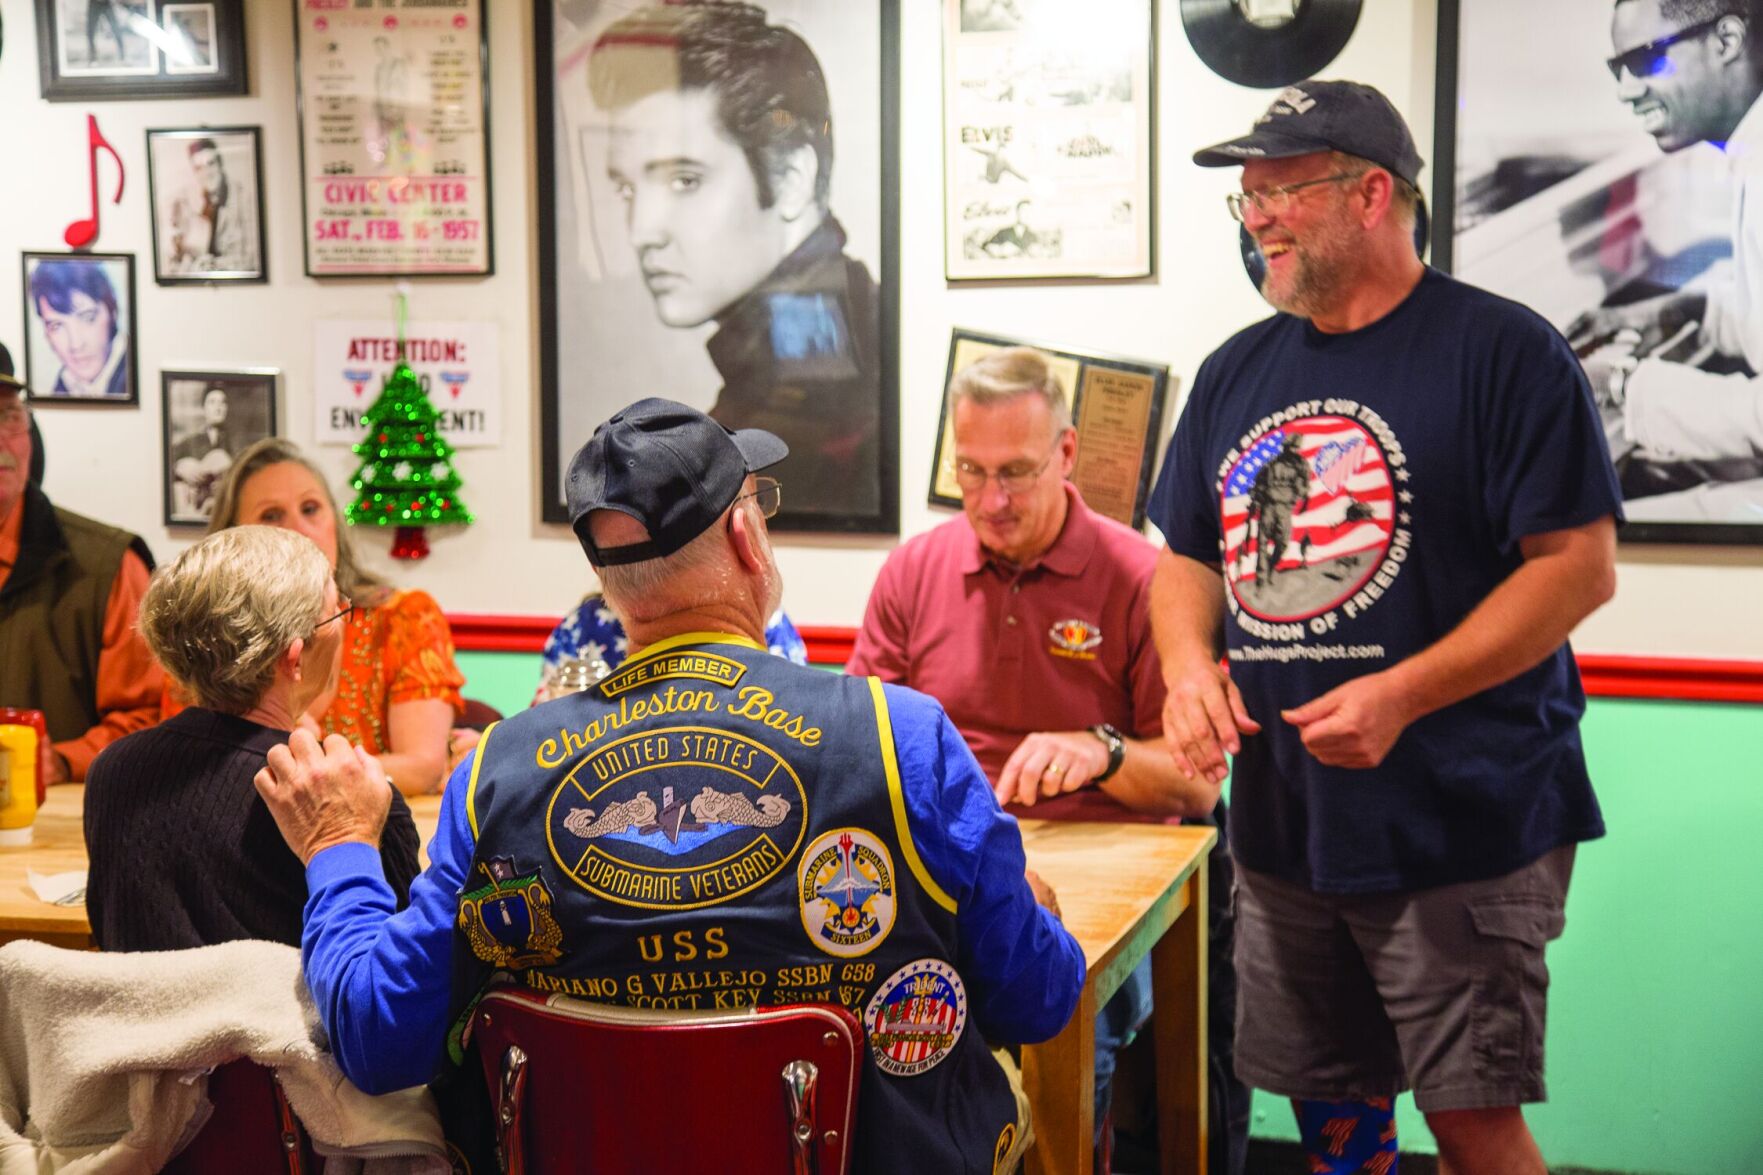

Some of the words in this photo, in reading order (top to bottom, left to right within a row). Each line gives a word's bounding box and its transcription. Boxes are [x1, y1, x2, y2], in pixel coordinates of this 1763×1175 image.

[961, 126, 1013, 144] ELVIS
[324, 182, 379, 204] CIVIC
[387, 182, 467, 204] CENTER
[347, 338, 467, 363] ATTENTION:
[1240, 400, 1322, 449] SUPPORT
[1323, 397, 1360, 416] OUR
[1357, 404, 1407, 467] TROOPS
[1236, 610, 1305, 640] MISSION
[1309, 610, 1340, 635] OF
[1342, 527, 1413, 619] FREEDOM
[612, 667, 648, 690] LIFE
[653, 658, 732, 679] MEMBER
[535, 686, 720, 769] Charleston
[727, 686, 823, 747] Base
[591, 737, 669, 781] UNITED
[681, 734, 758, 770] STATES
[580, 855, 683, 902] SUBMARINE
[689, 843, 777, 900] VETERANS
[804, 846, 837, 901] SUBMARINE
[858, 846, 891, 890] SQUADRON
[638, 927, 730, 963] USS
[830, 929, 872, 945] SIXTEEN
[526, 968, 618, 998] MARIANO
[626, 975, 643, 995] G
[651, 970, 767, 994] VALLEJO
[777, 963, 833, 988] SSBN
[841, 963, 876, 983] 658
[714, 987, 762, 1010] KEY
